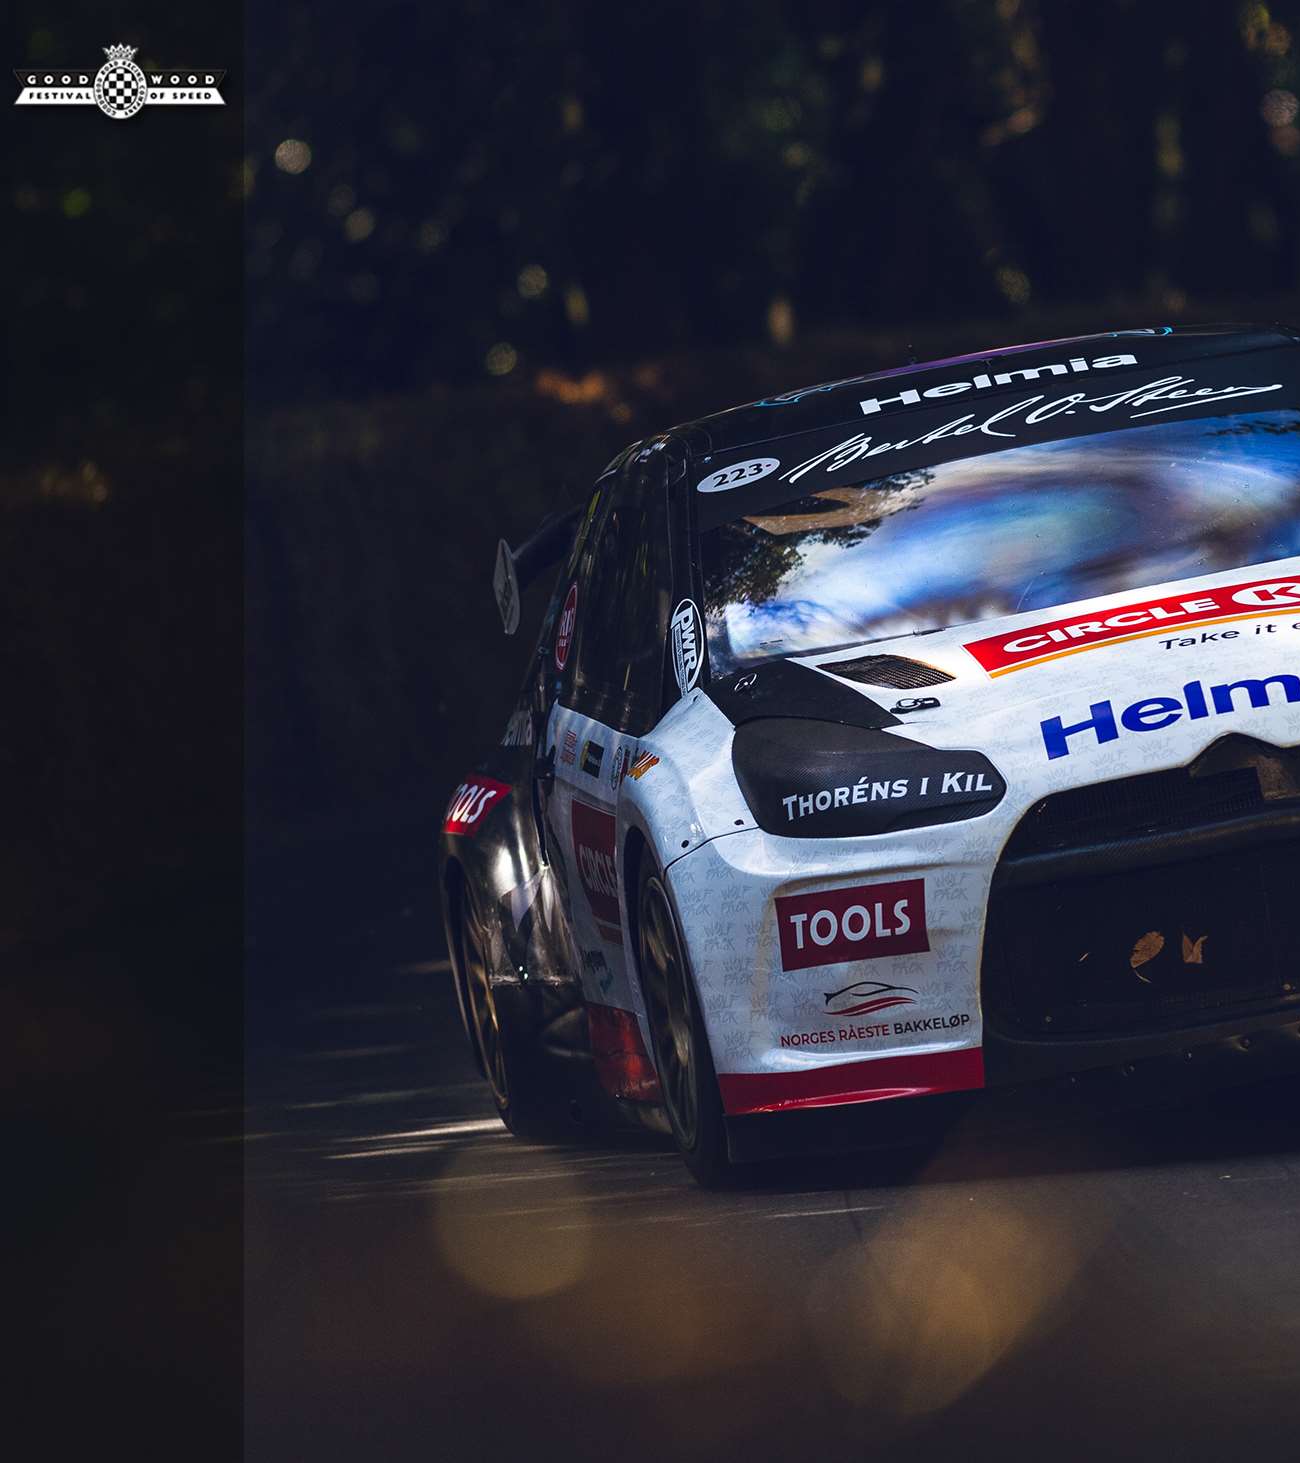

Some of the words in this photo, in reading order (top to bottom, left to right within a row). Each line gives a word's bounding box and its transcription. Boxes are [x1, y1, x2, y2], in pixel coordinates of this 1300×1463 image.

[860, 353, 1138, 414] Helmia
[671, 605, 698, 690] PWR
[1002, 596, 1221, 654] CIRCLE
[1158, 628, 1240, 651] Take
[1255, 623, 1277, 635] it
[790, 899, 911, 950] TOOLS
[780, 1030, 836, 1048] NORGES
[838, 1024, 890, 1042] RÅESTE
[893, 1013, 971, 1035] BAKKELØP
